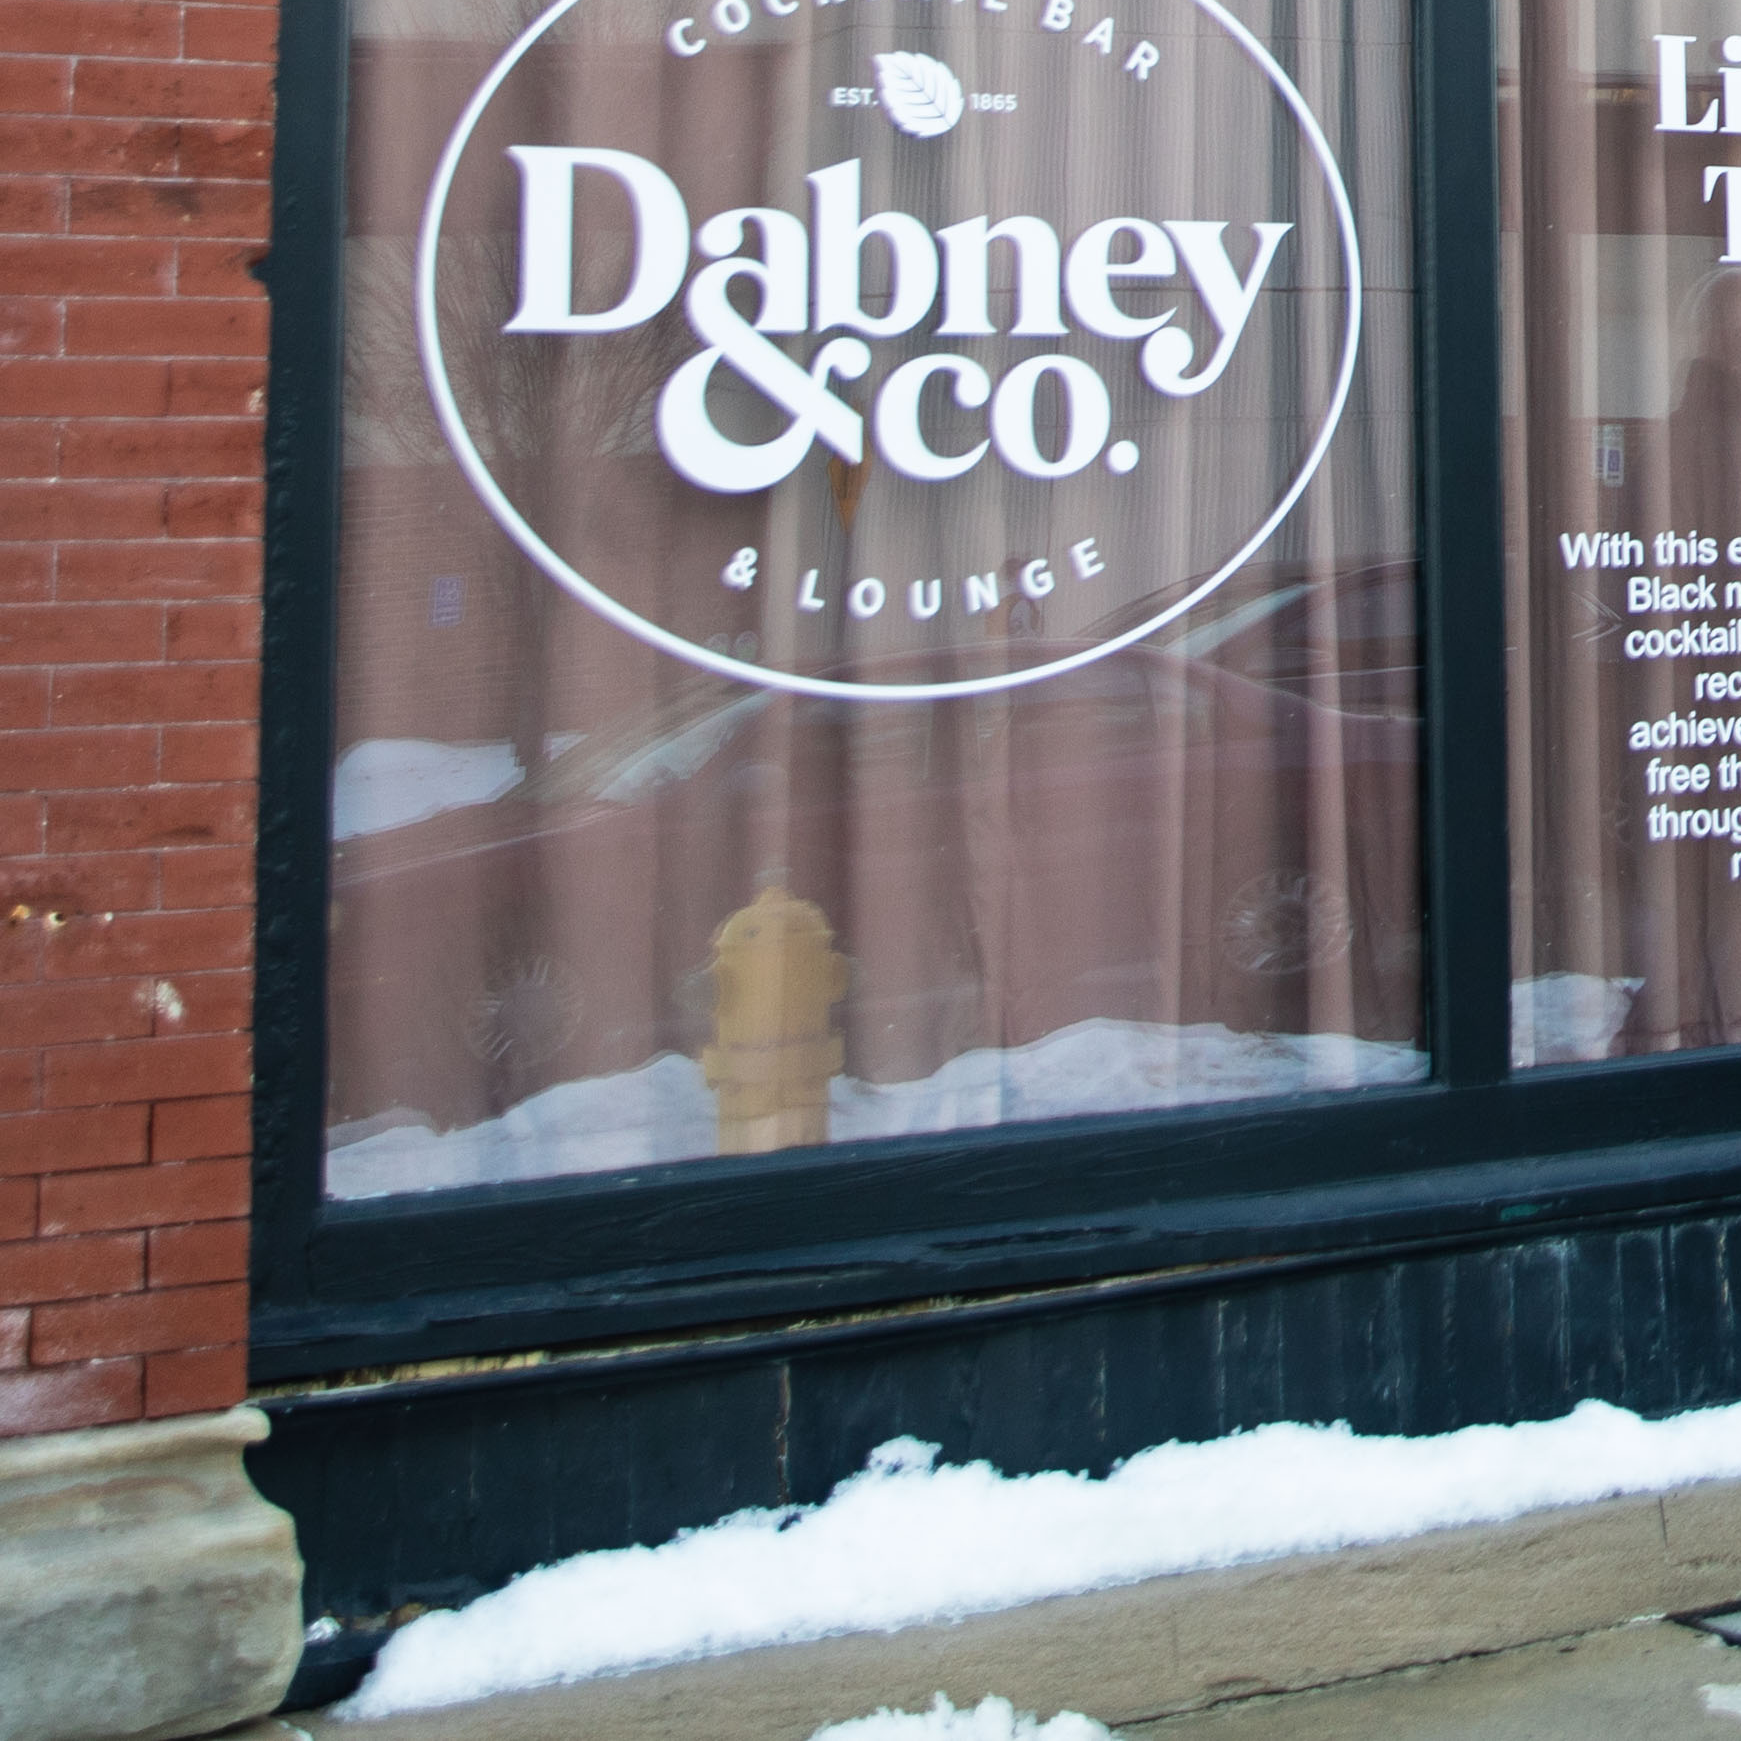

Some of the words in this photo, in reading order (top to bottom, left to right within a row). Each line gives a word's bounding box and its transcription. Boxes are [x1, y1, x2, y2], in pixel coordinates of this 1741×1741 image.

[831, 87, 879, 106] EST.
[970, 93, 1018, 112] 1865
[501, 145, 1294, 398] Dabney
[657, 260, 1139, 492] &co.
[1560, 532, 1644, 569] With
[1654, 530, 1718, 565] this
[724, 548, 759, 589] &
[800, 539, 1105, 619] LOUNGE
[1628, 576, 1717, 613] Black
[1646, 758, 1710, 794] free
